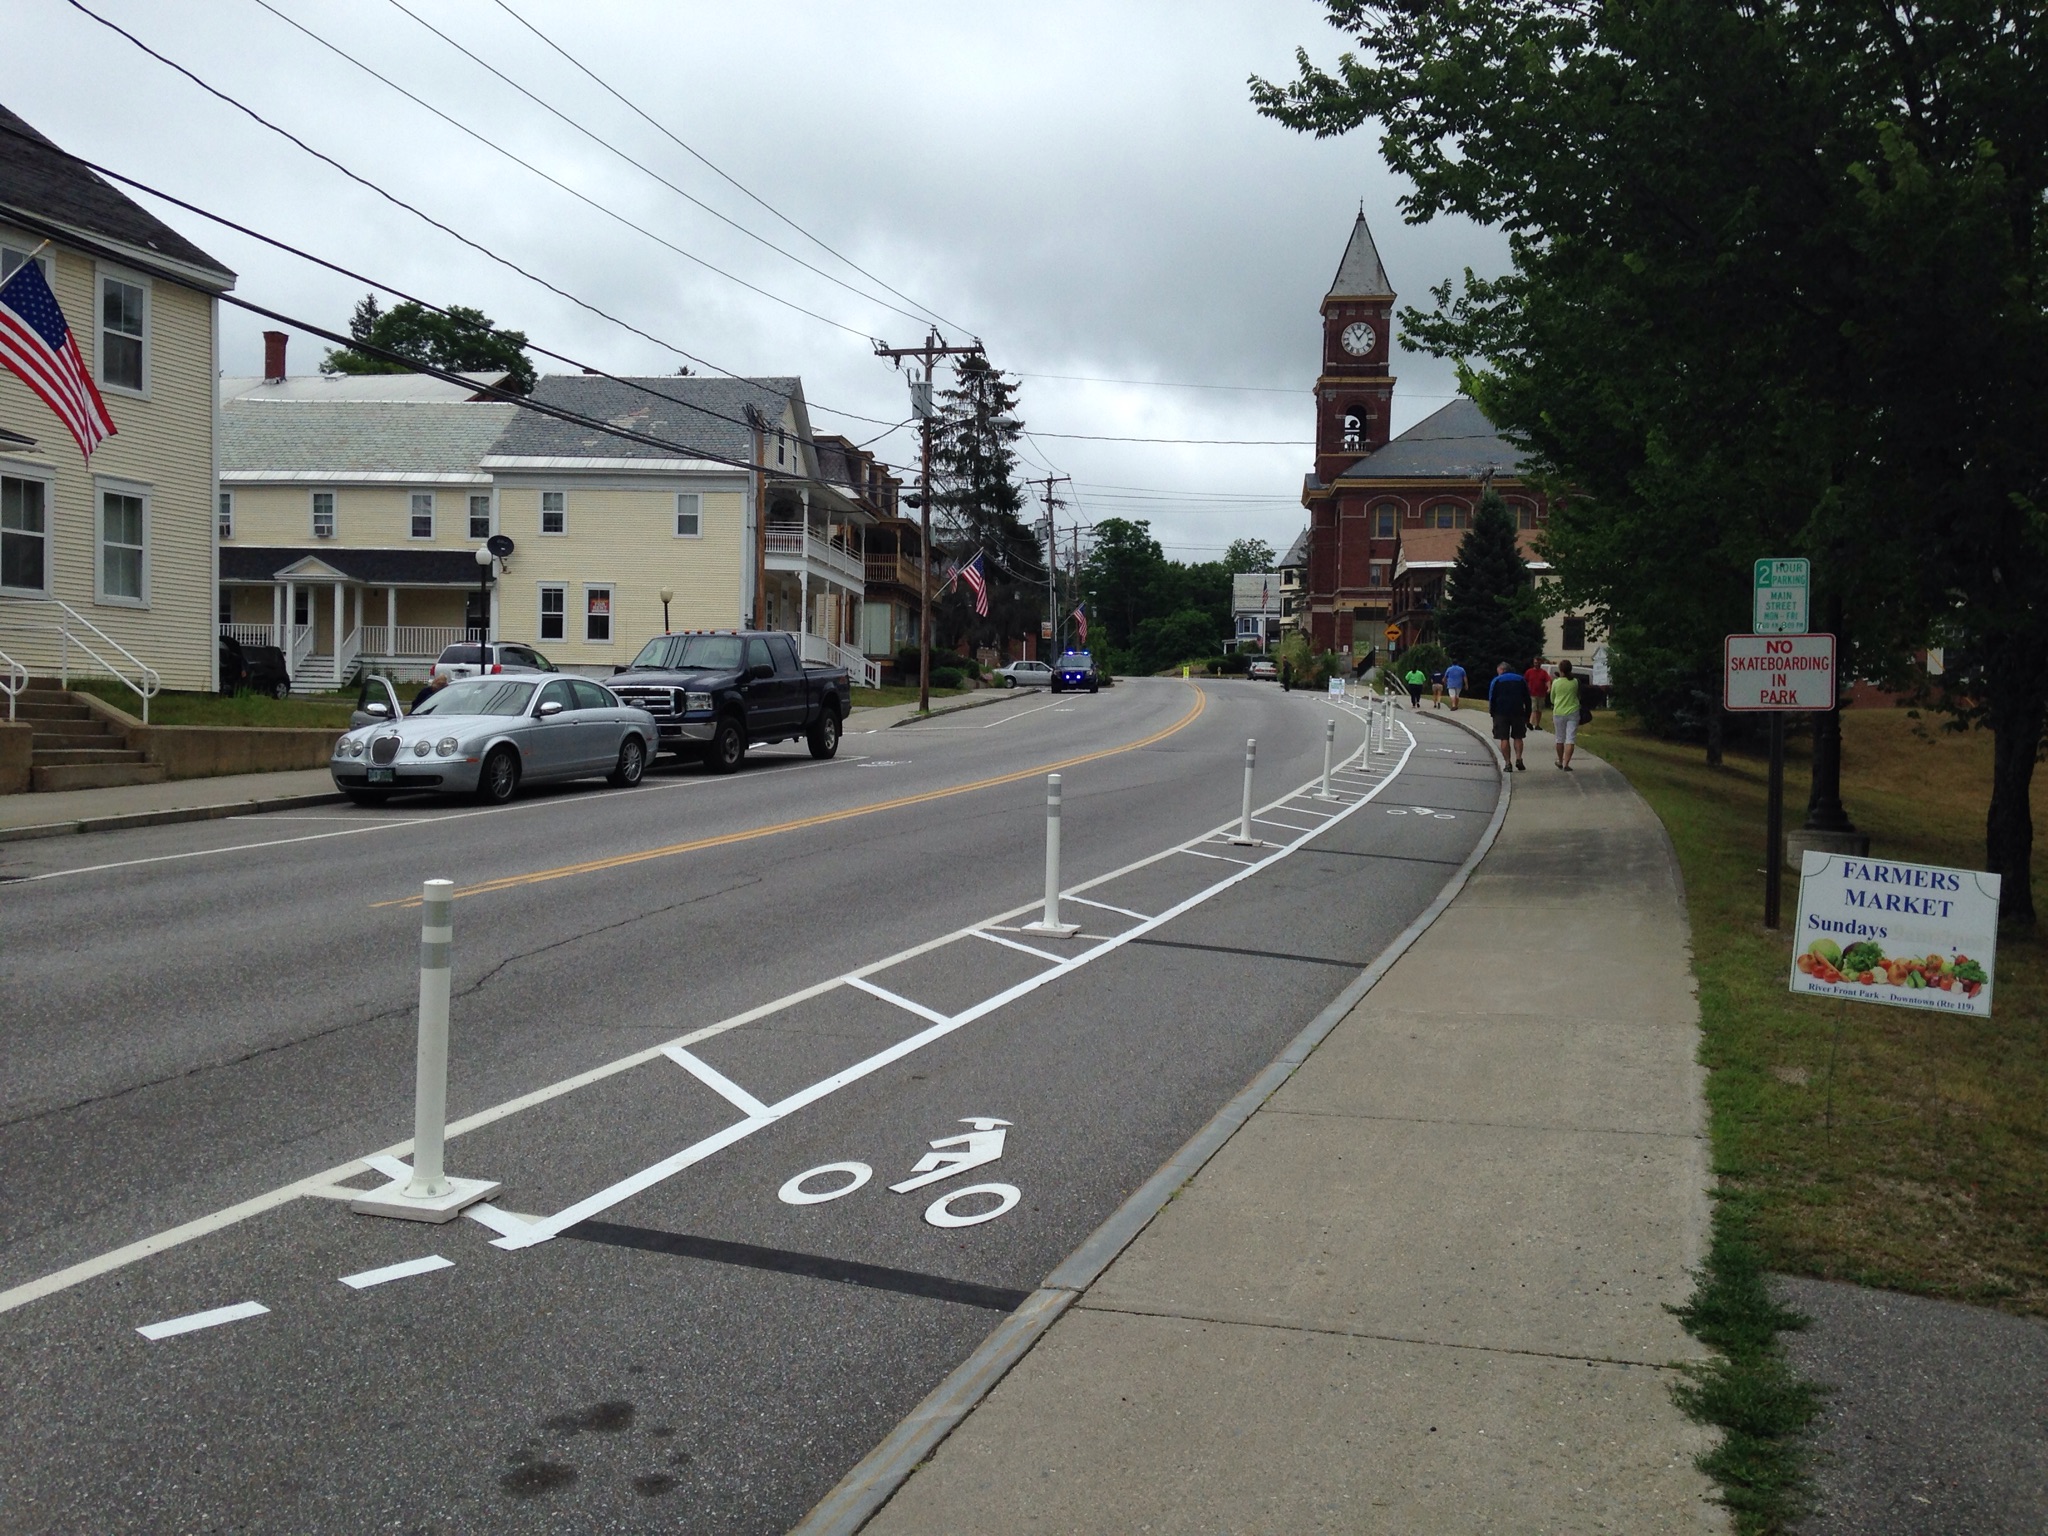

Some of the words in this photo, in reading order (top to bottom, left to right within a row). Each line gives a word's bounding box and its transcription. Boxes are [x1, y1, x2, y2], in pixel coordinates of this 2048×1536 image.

[1759, 566, 1770, 584] 2
[1776, 563, 1802, 573] HOUR
[1773, 575, 1805, 585] PARKING
[1771, 591, 1792, 600] MAIN
[1766, 602, 1797, 610] STREET
[1764, 612, 1779, 620] MON
[1786, 612, 1798, 620] FRI
[1766, 640, 1792, 654] NO
[1731, 657, 1829, 671] SKATEBOARDING
[1772, 674, 1786, 686] IN
[1760, 690, 1797, 704] PARK
[1843, 862, 1960, 891] FARMERS
[1845, 889, 1954, 918] MARKET
[1808, 914, 1888, 940] Sundays
[1809, 983, 1831, 993] River
[1834, 986, 1857, 996] Front
[1859, 989, 1879, 999] Park
[1890, 993, 1935, 1006] Downtown
[1937, 1000, 1955, 1009] (Rte
[1957, 1002, 1974, 1012] 119)
